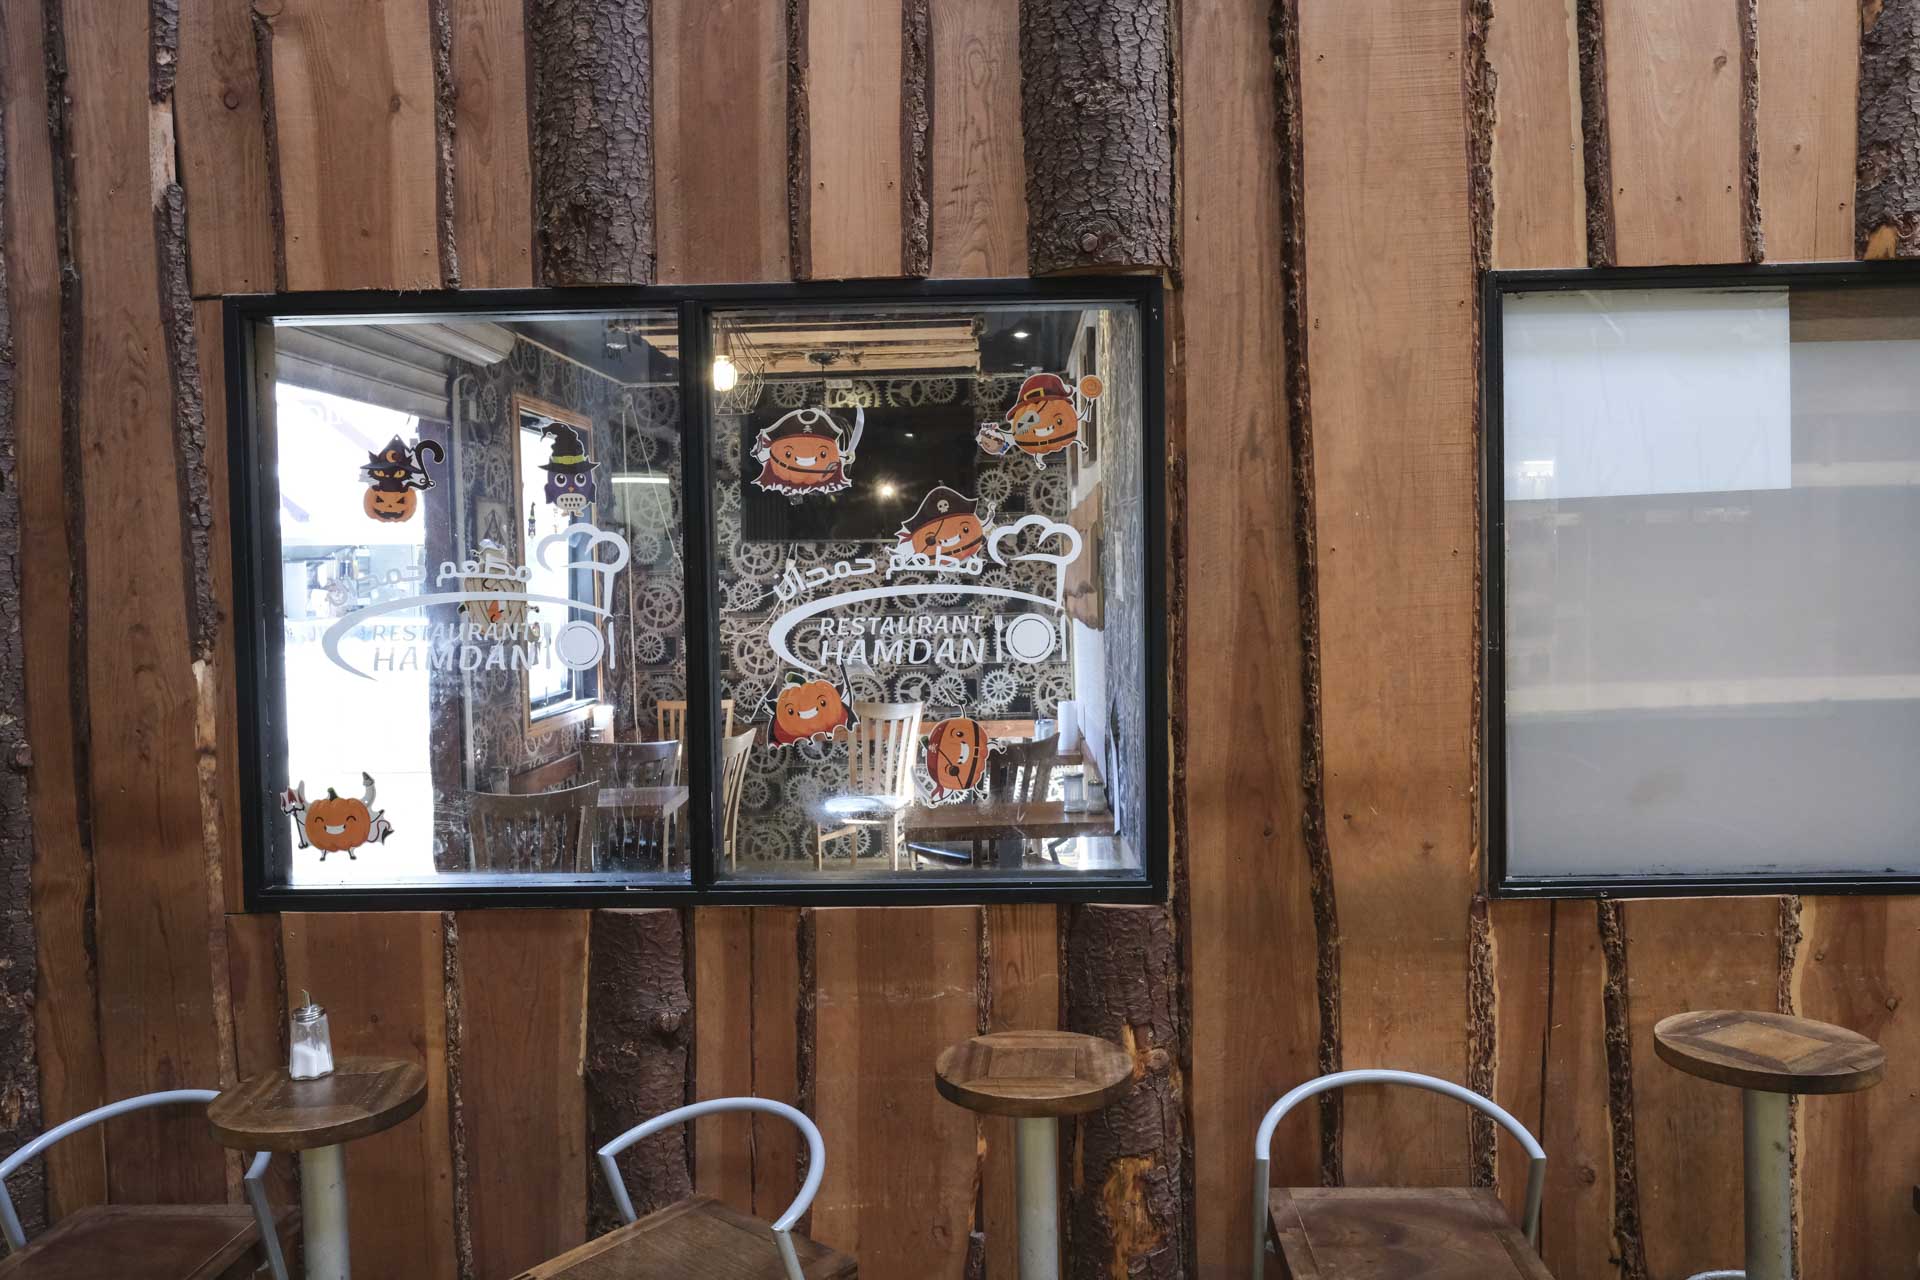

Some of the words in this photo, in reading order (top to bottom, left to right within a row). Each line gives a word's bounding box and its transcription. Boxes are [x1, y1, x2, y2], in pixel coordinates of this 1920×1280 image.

[886, 546, 983, 579] مطعم
[773, 557, 876, 601] حمدان
[373, 622, 533, 642] RESTAURANT
[820, 615, 986, 636] RESTAURANT
[373, 645, 534, 672] HAMDAN
[820, 637, 986, 666] HAMDAN
